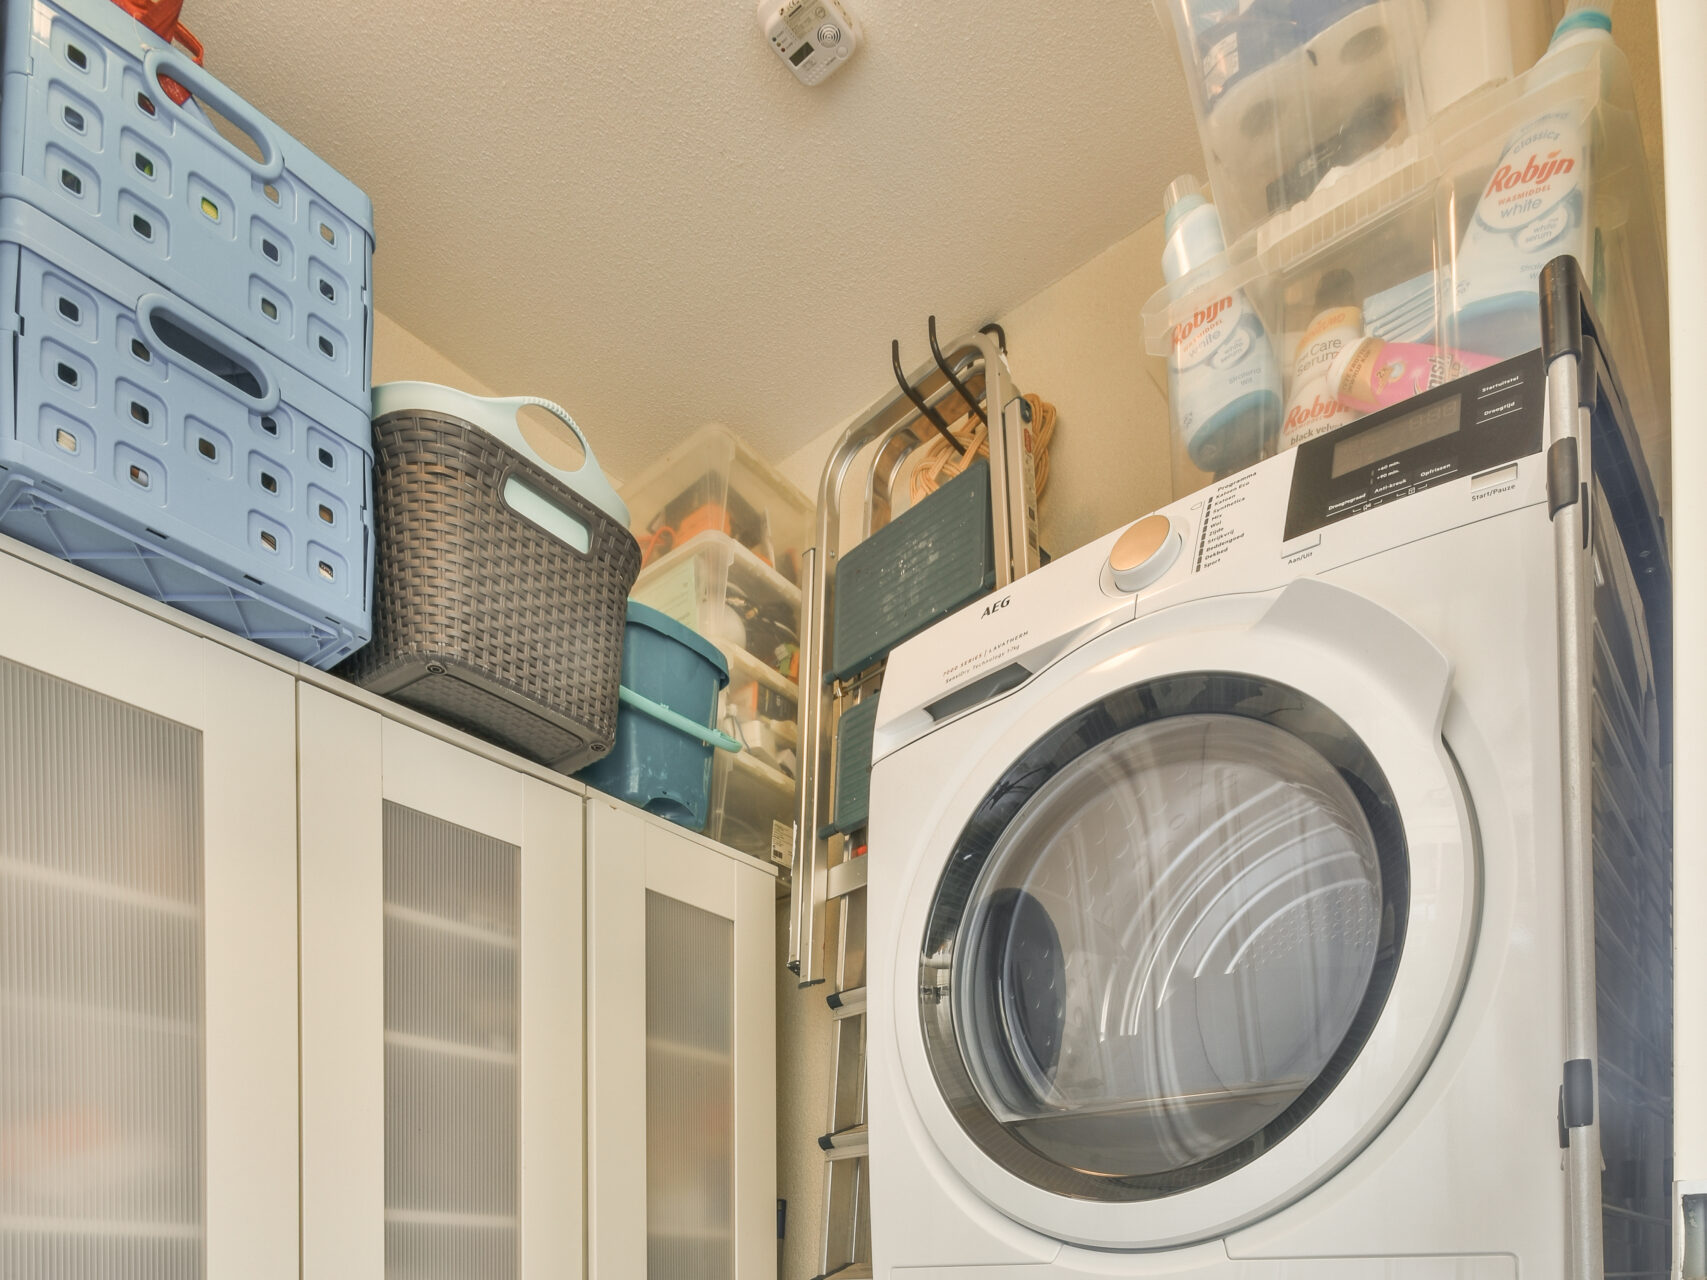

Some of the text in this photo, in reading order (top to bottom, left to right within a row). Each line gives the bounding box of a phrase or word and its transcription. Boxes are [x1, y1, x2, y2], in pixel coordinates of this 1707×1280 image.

[1484, 150, 1576, 199] Robijn
[1498, 185, 1552, 206] WASMIDDEL
[1500, 197, 1543, 219] white
[1171, 295, 1233, 356] Robijn
[1310, 337, 1342, 354] Care
[1482, 375, 1519, 393] Startuitstel
[1483, 401, 1516, 416] Droogtijd
[1420, 463, 1451, 477] Opfrissen
[1217, 472, 1257, 492] Programma
[1374, 478, 1407, 494] Anti-kreuk
[1471, 483, 1516, 502] Start/Pauze
[1287, 552, 1313, 565] Aan/Uit
[981, 595, 1011, 620] AEG
[960, 653, 983, 669] SERIES
[988, 630, 1029, 654] LAVATHERM
